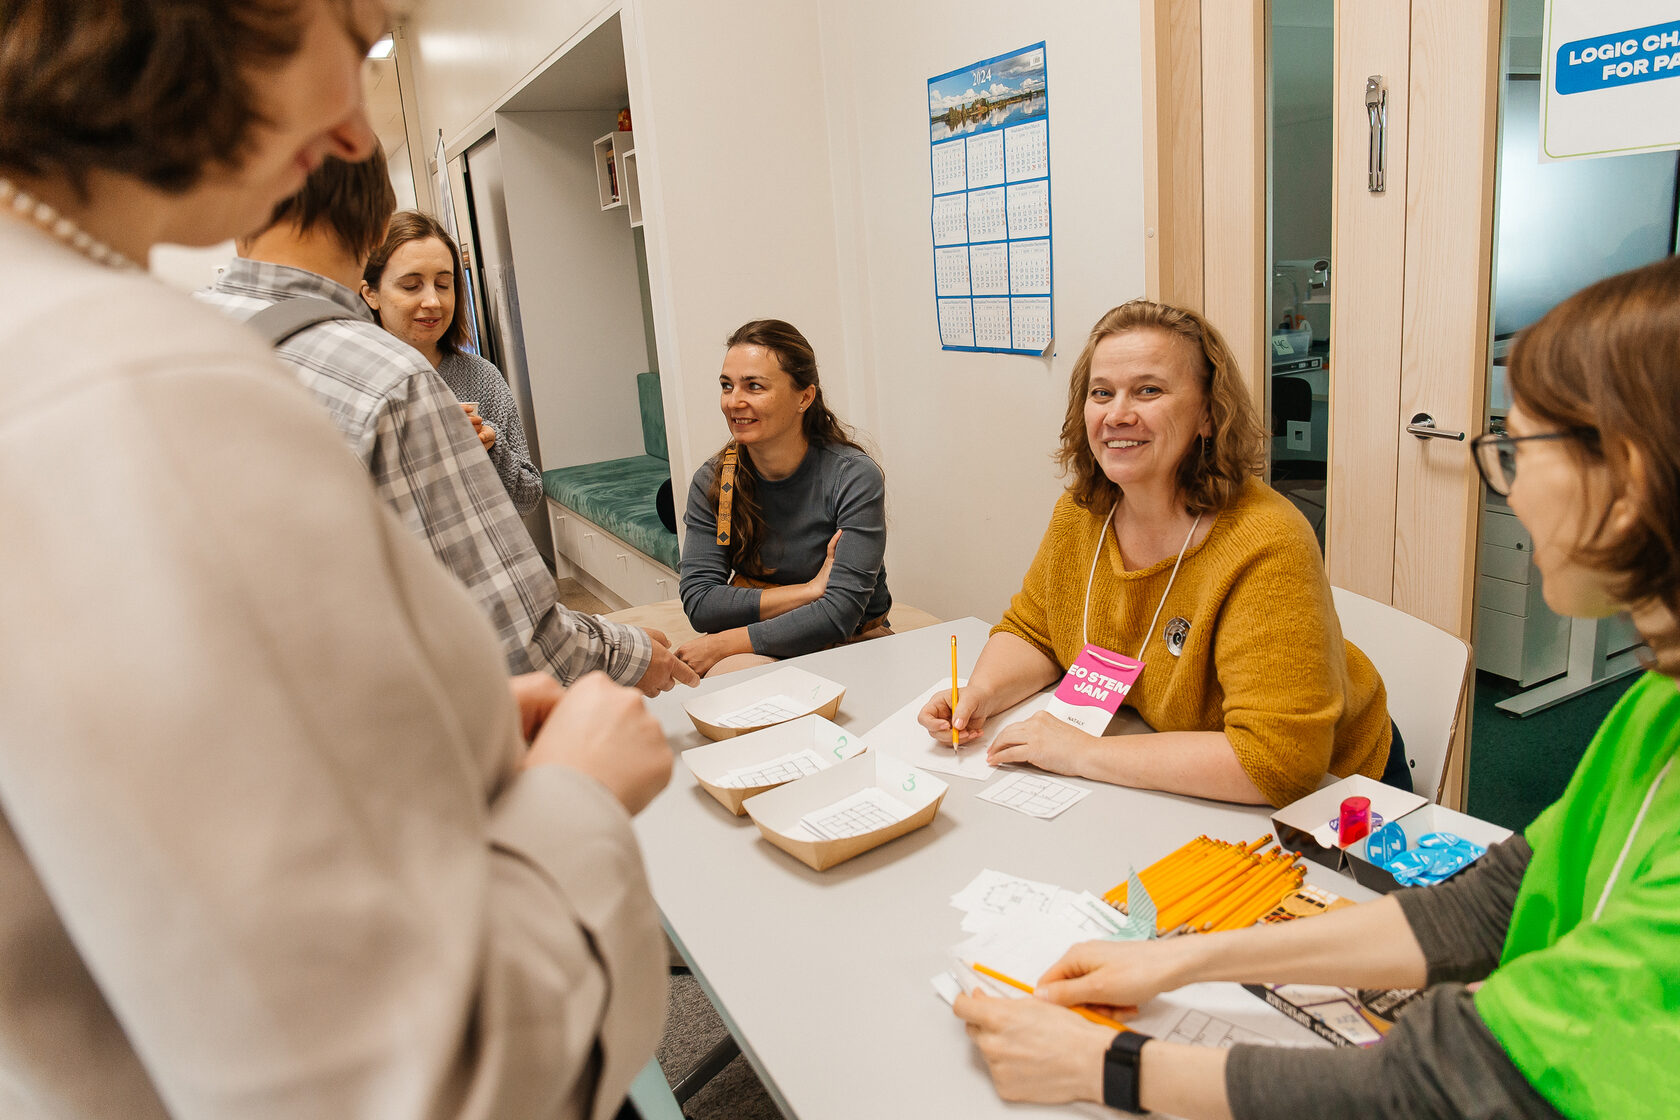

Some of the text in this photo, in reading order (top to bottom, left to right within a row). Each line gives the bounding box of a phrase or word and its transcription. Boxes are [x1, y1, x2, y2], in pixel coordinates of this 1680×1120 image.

[1569, 39, 1638, 66] LOGIC
[972, 69, 992, 87] 2024
[1602, 58, 1649, 81] FOR
[1073, 681, 1109, 702] JAM
[1087, 671, 1131, 696] STEM
[833, 735, 848, 760] 2
[902, 773, 916, 792] 3
